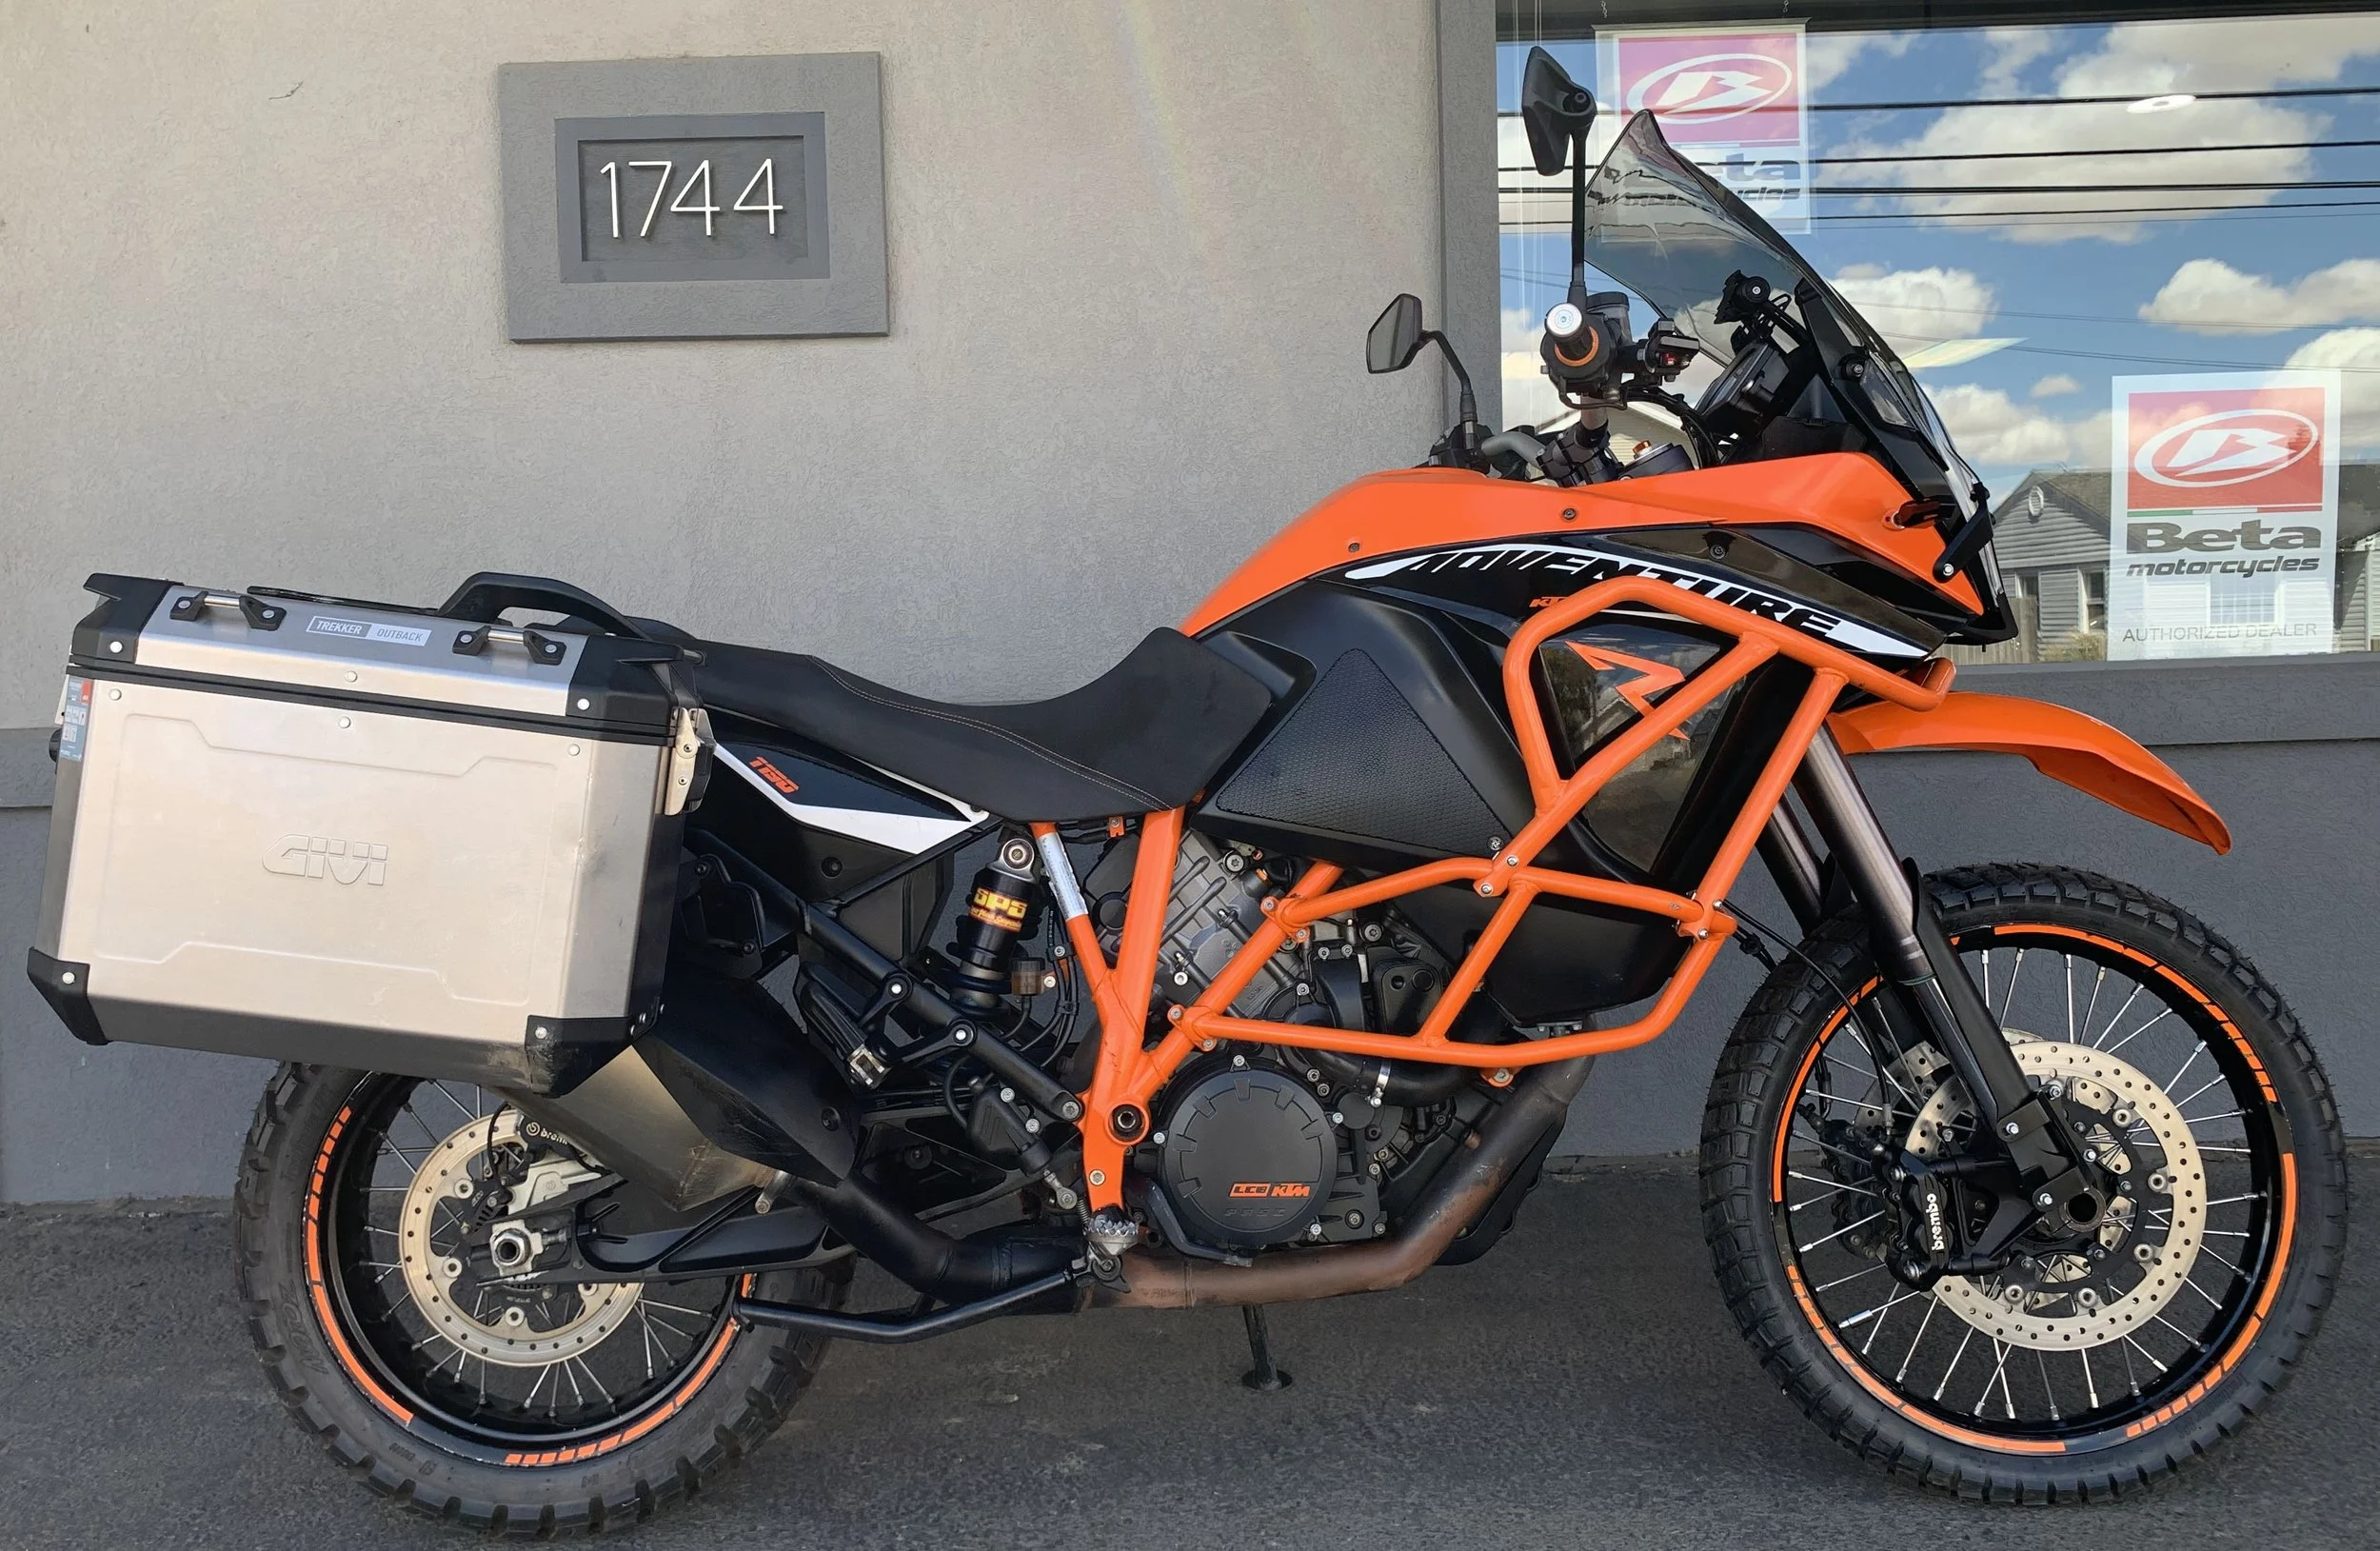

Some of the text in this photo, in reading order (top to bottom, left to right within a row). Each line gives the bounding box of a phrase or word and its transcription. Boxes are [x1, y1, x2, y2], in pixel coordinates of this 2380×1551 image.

[600, 158, 784, 238] 1744
[2126, 519, 2322, 554] Beta
[2126, 555, 2321, 579] motorcycles
[316, 620, 424, 643] TREKKER OUTBACK
[2122, 623, 2318, 643] AUTHORIZED DEALER
[261, 833, 389, 886] GIVI
[540, 1127, 569, 1145] brem
[1271, 1183, 1311, 1197] KTM
[1925, 1193, 1945, 1251] brembo
